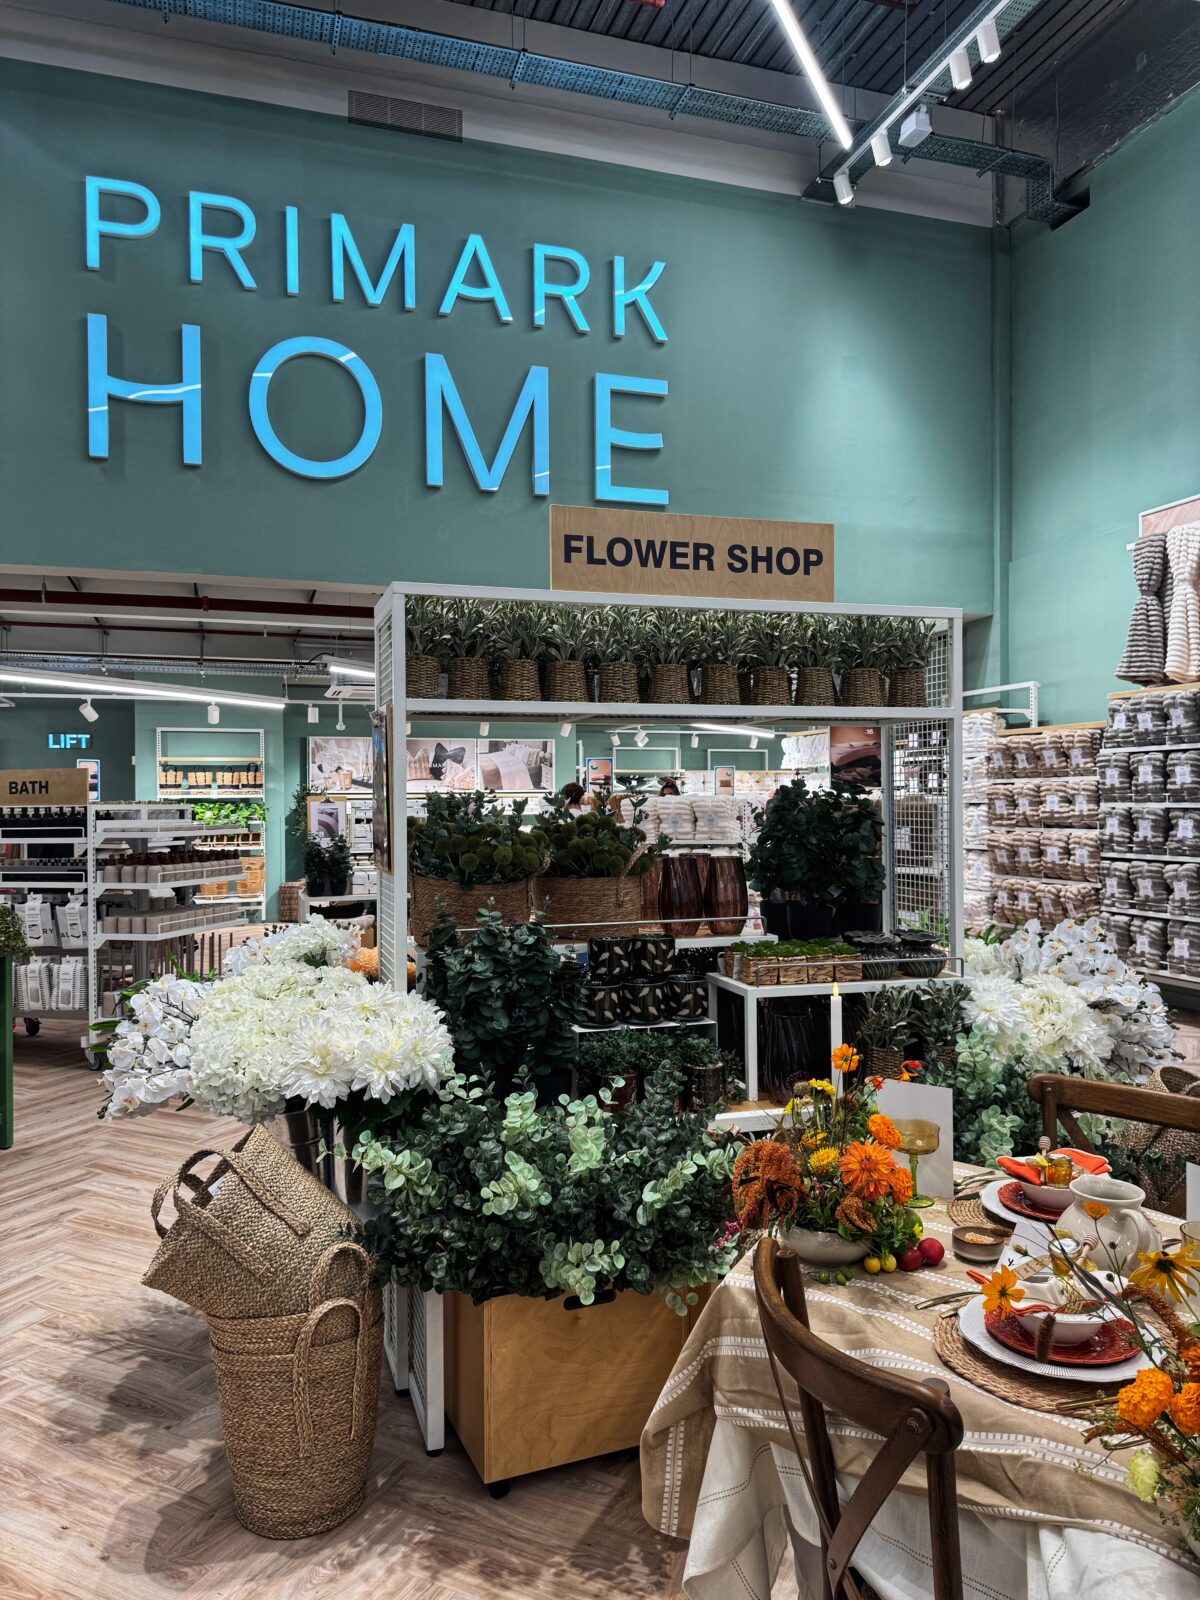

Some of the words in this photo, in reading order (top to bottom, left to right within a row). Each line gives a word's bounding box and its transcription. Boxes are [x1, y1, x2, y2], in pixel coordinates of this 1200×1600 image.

[85, 175, 669, 343] PRIMARK
[87, 312, 670, 506] HOME
[563, 534, 715, 571] FLOWER
[726, 543, 824, 576] SHOP
[48, 733, 91, 749] LIFT
[8, 780, 49, 795] BATH
